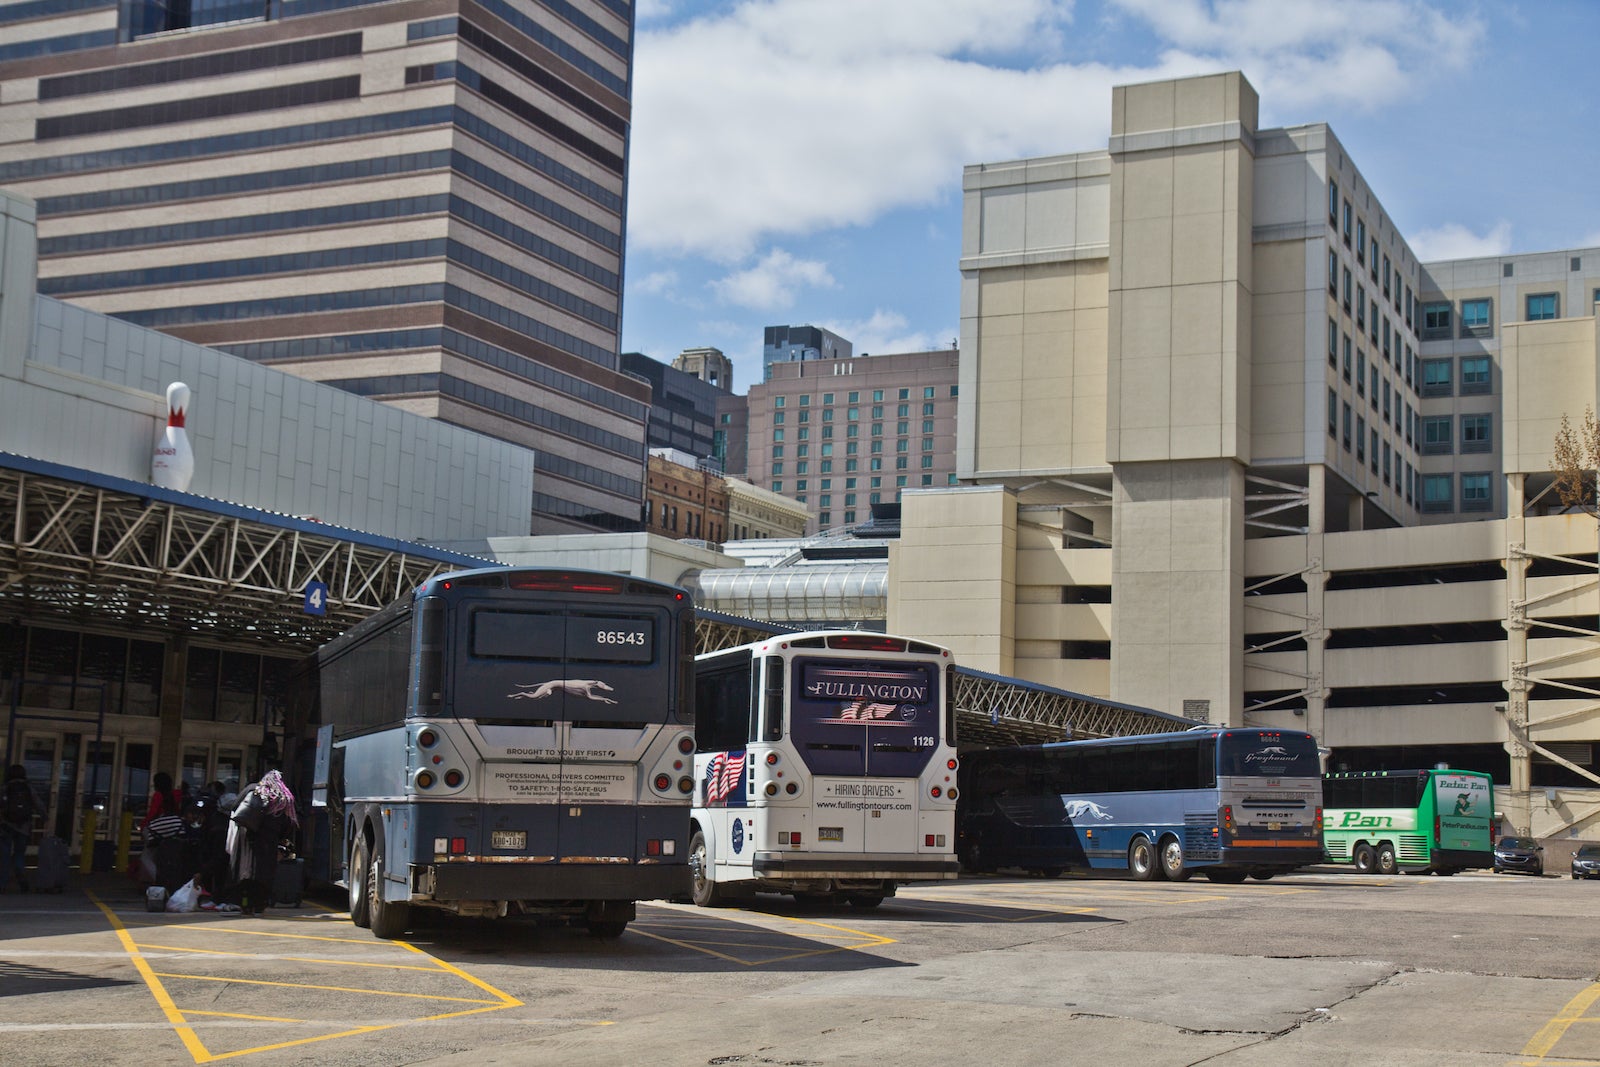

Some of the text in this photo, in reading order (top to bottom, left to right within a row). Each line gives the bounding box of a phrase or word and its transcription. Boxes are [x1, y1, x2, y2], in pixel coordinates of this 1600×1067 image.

[823, 336, 833, 350] W
[310, 588, 322, 609] 4
[597, 631, 645, 645] 86543
[807, 681, 924, 699] FULLINGTON
[912, 735, 935, 747] 1126
[506, 748, 543, 756] BROUGHT
[1244, 753, 1300, 763] Greyhound
[834, 784, 895, 797] HIRING DRIVERS
[1439, 780, 1487, 790] Peter Pan
[816, 801, 912, 811] www.fullingtontours.com
[1339, 811, 1393, 827] Pan
